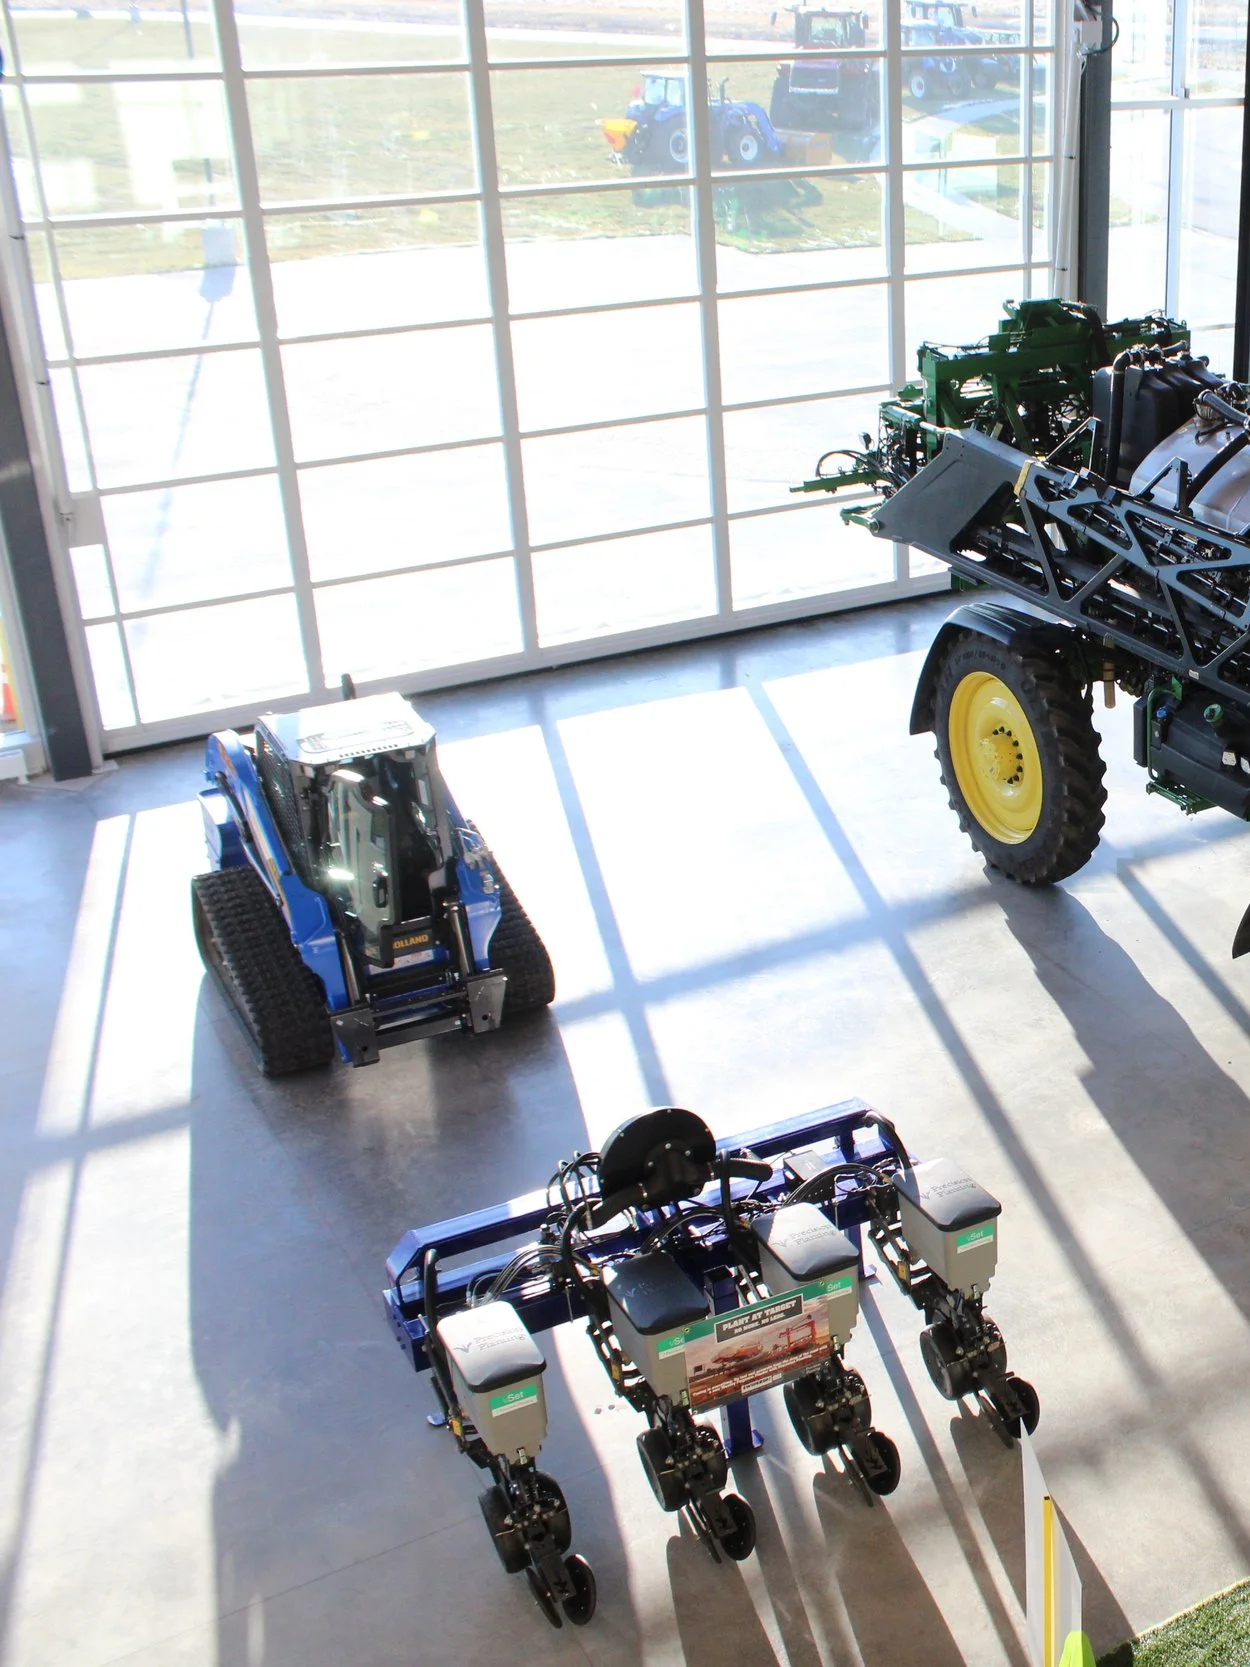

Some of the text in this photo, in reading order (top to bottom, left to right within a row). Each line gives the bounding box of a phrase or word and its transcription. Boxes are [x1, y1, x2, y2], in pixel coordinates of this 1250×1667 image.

[393, 934, 429, 949] OLLAND
[827, 1281, 841, 1292] Set
[722, 1300, 797, 1331] PLANT AT TARGET
